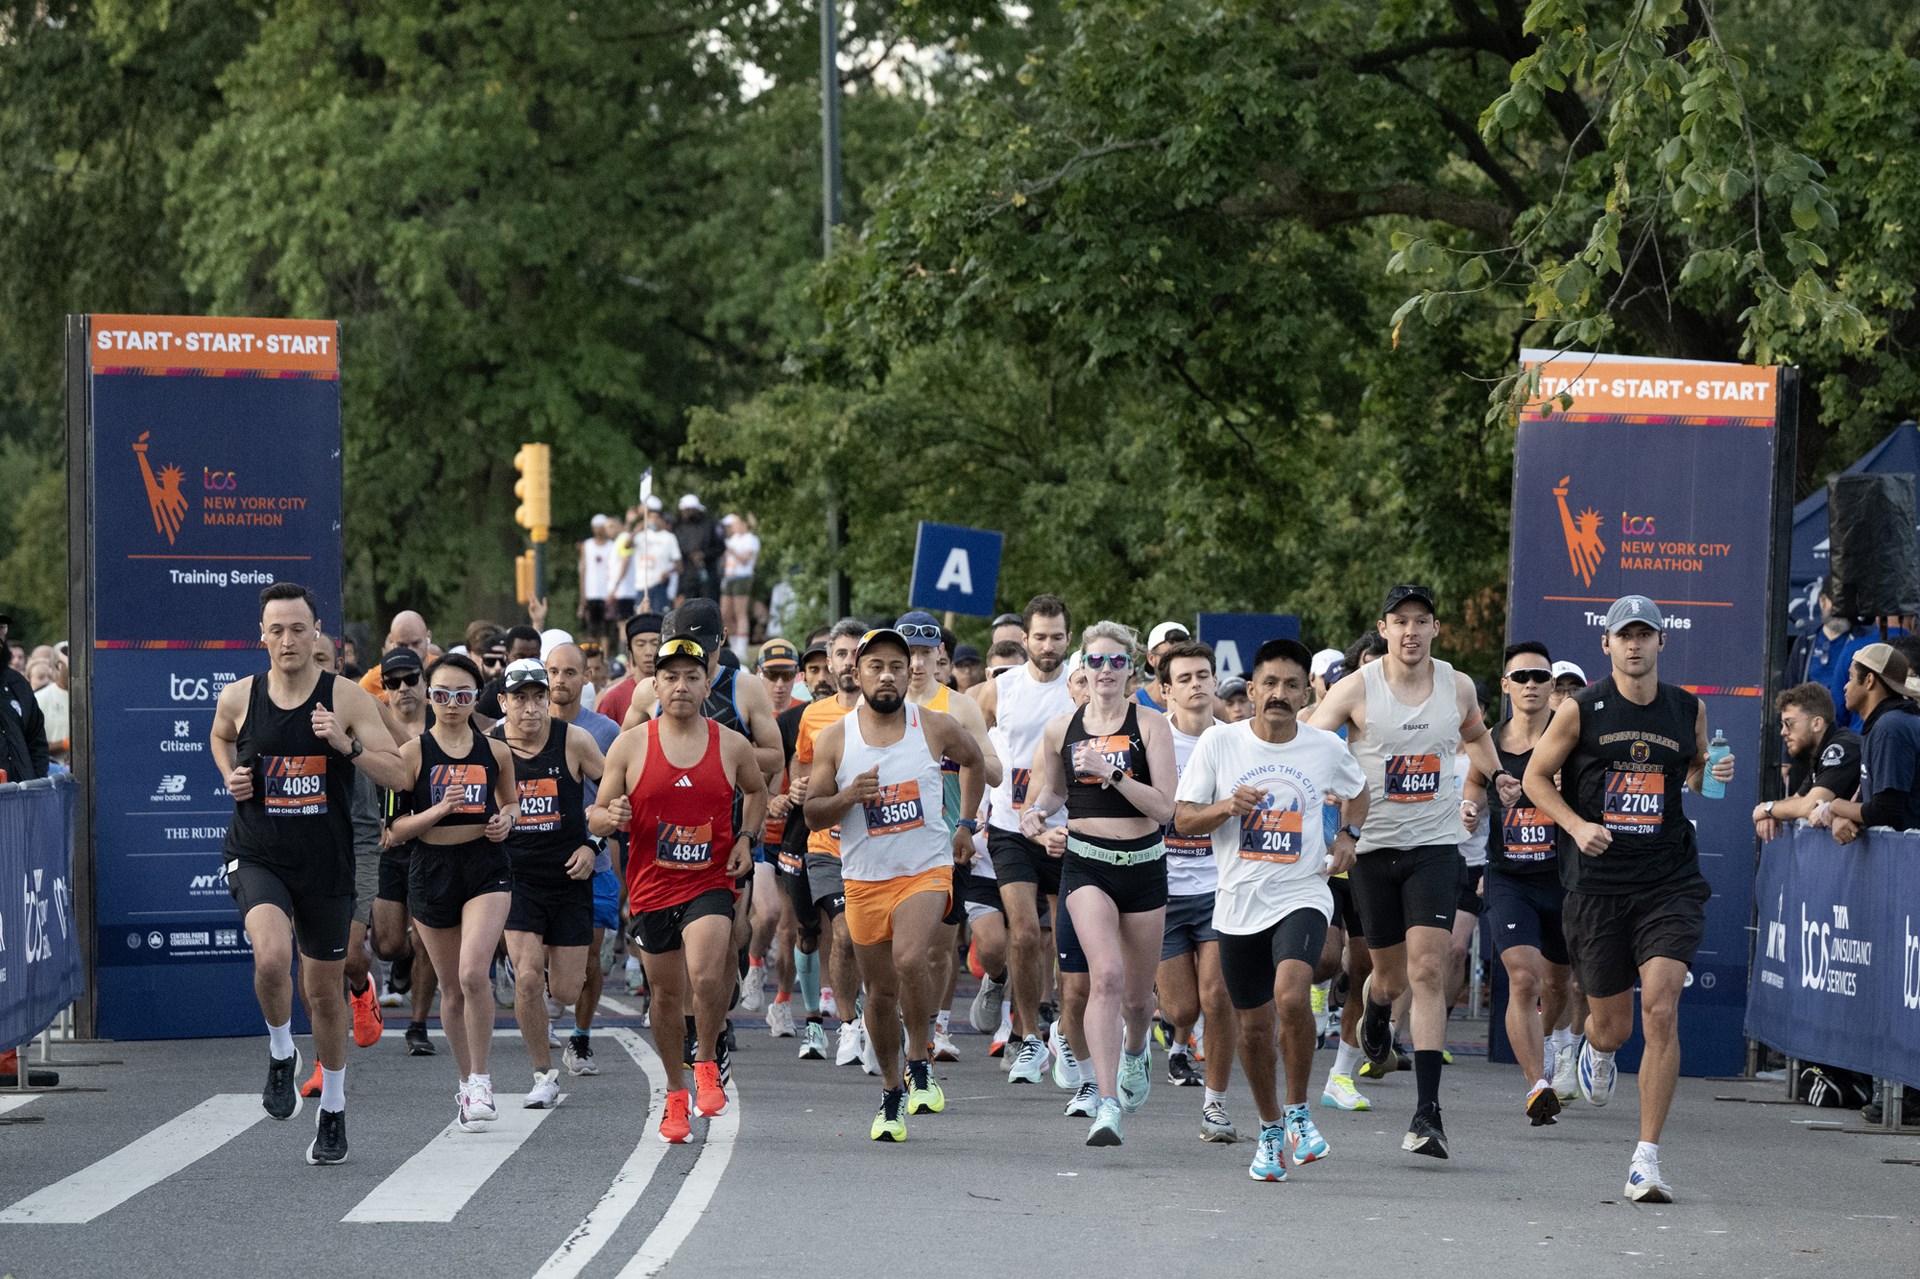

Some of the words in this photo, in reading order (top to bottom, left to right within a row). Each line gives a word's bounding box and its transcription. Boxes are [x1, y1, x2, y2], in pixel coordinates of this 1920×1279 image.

[97, 330, 172, 351] START
[185, 332, 255, 352] START
[266, 334, 330, 355] START
[1611, 378, 1684, 398] START
[1696, 380, 1769, 401] START
[203, 466, 237, 490] tcs
[203, 497, 236, 509] NEW
[240, 497, 275, 510] YORK
[278, 498, 307, 510] CITY
[203, 513, 282, 526] MARATHON
[1621, 511, 1655, 535] tcs
[1621, 541, 1655, 554] NEW
[1658, 542, 1696, 555] YORK
[1699, 543, 1731, 557] CITY
[935, 547, 973, 595] A
[1620, 558, 1702, 571] MARATHON
[170, 570, 227, 587] Training
[230, 570, 274, 584] Series
[1661, 614, 1691, 629] ries
[171, 673, 208, 700] tcs
[160, 740, 203, 752] Citizens
[1641, 731, 1680, 752] COLLEGE
[1613, 761, 1663, 773] LACROSSE
[283, 775, 320, 795] 4089
[1279, 765, 1303, 780] THIS
[1303, 778, 1317, 801] CITY
[1402, 772, 1435, 792] 4644
[302, 805, 318, 814] 4089
[521, 797, 552, 814] 4297
[881, 800, 917, 824] 3560
[1621, 794, 1659, 813] 2704
[165, 828, 189, 839] THE
[539, 822, 554, 831] 4297
[1521, 826, 1546, 843] 819
[1638, 825, 1654, 833] 2704
[1262, 831, 1291, 851] 204
[673, 843, 708, 860] 4847
[1534, 852, 1545, 860] 819
[1802, 901, 1830, 991] tcs
[1904, 914, 1920, 1010] tc
